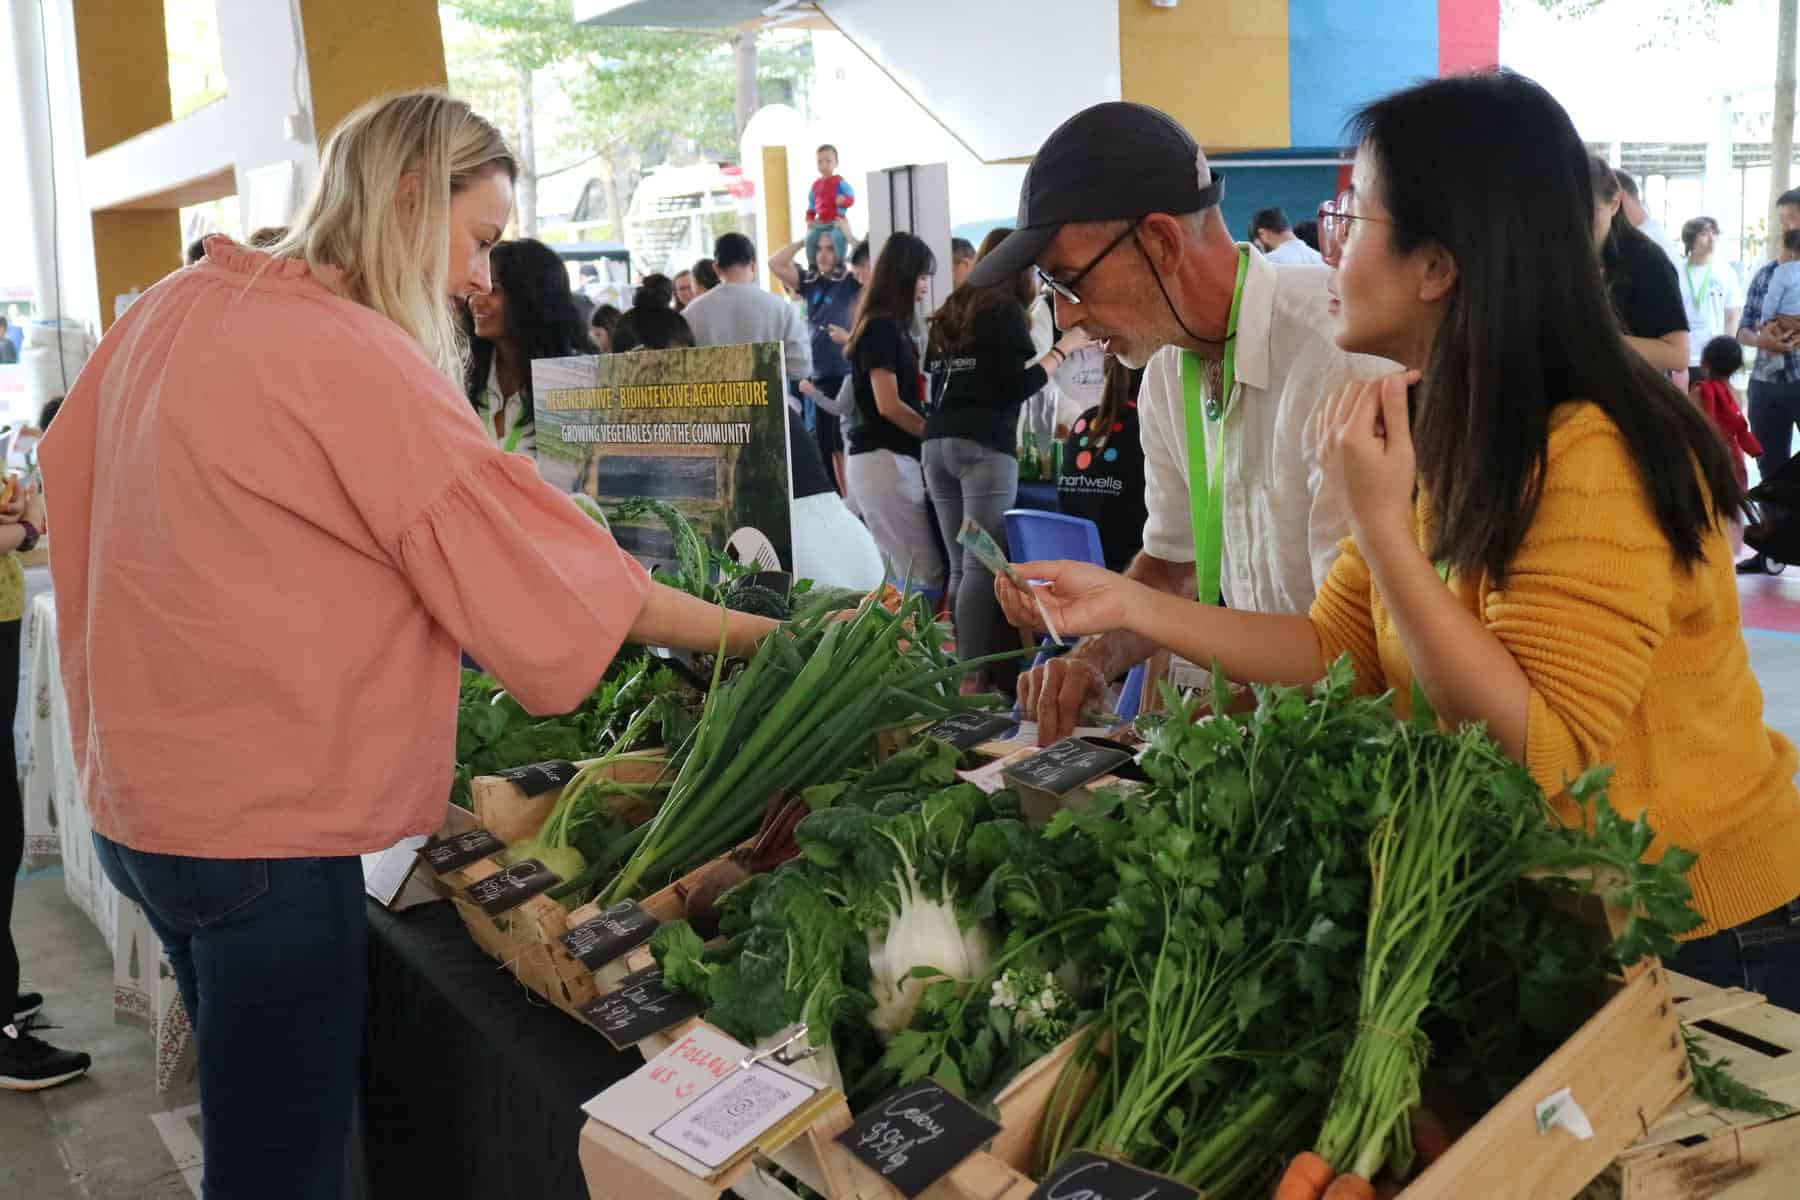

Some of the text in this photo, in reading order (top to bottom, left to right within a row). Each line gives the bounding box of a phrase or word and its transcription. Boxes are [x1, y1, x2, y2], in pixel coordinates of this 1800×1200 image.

[619, 384, 691, 409] BIOINTENSIVE
[692, 381, 769, 406] AGRICULTURE
[561, 423, 751, 443] GROWING VEGETABLES FOR THE COMMUNITY
[1057, 473, 1122, 489] hartwells
[884, 1086, 945, 1144] Celery
